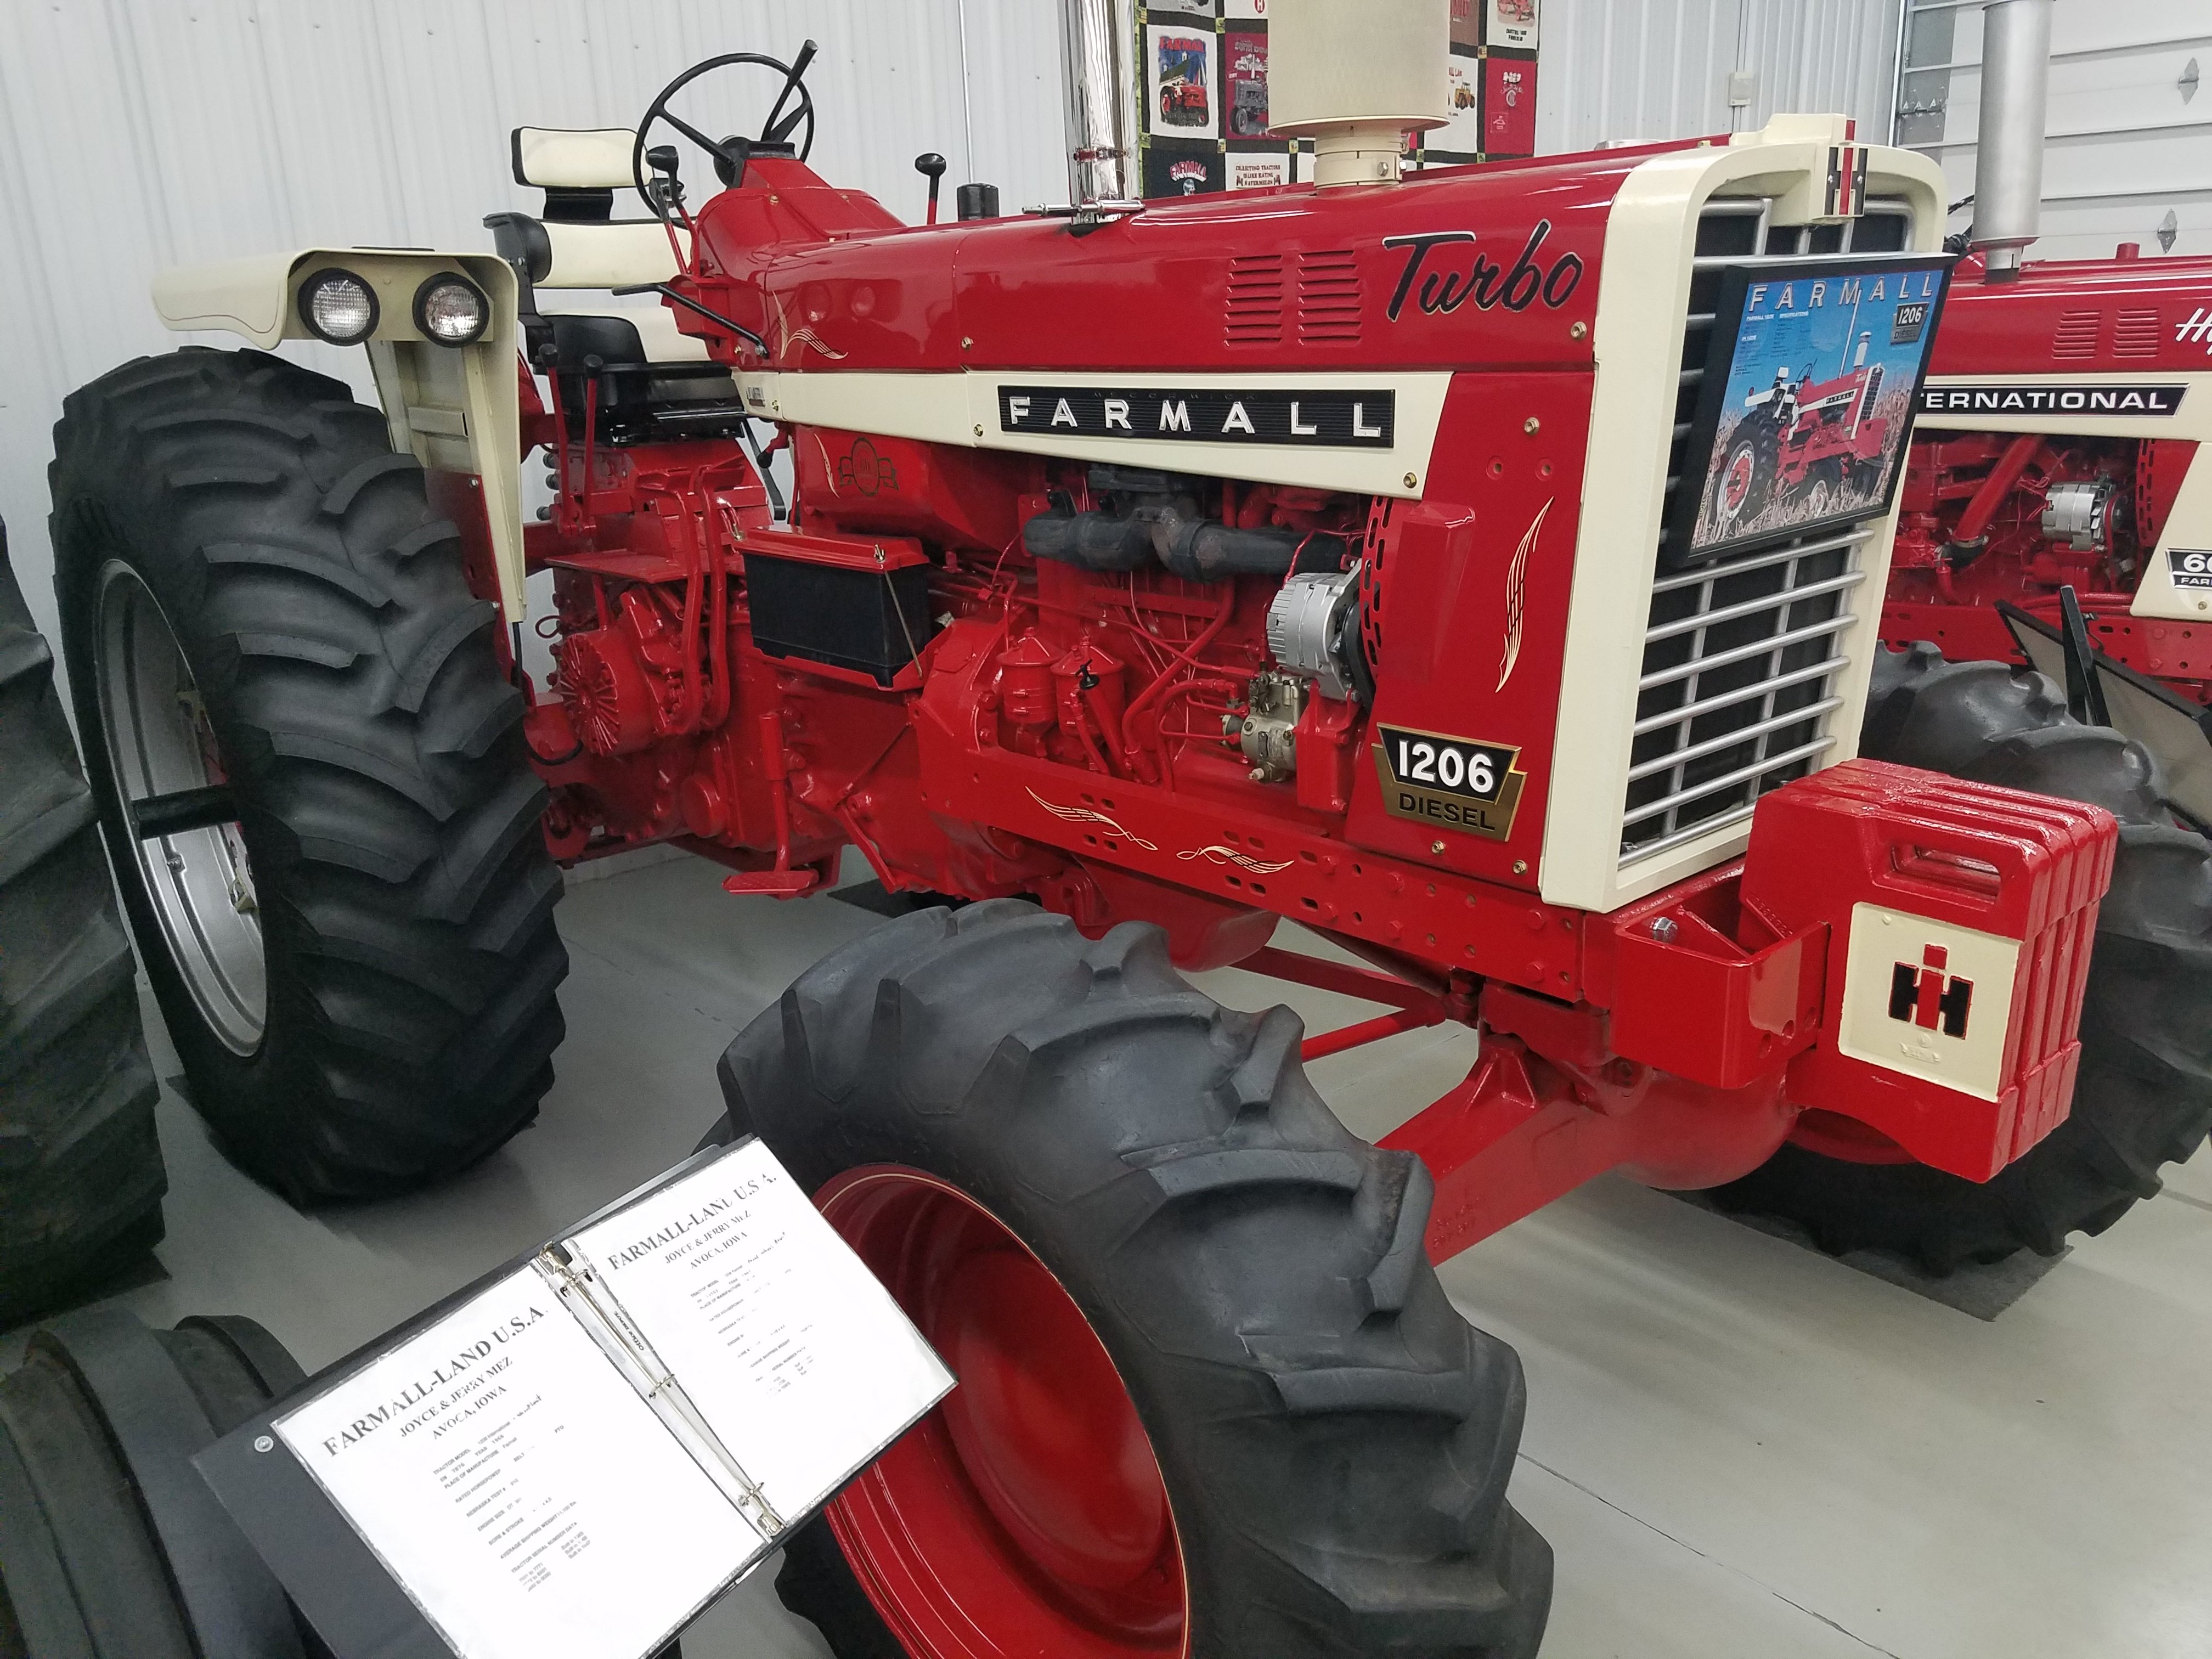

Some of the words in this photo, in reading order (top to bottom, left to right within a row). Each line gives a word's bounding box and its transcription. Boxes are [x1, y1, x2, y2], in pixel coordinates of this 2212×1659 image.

[1170, 160, 1206, 182] FARMALL
[1382, 218, 1584, 323] Turbo
[1748, 277, 1932, 312] FARMALL
[1898, 306, 1923, 325] 1206
[2175, 307, 2212, 356] H
[1009, 396, 1381, 437] FARMALL
[2181, 577, 2212, 585] FAR
[2183, 553, 2212, 572] 6
[1398, 740, 1494, 793] 1206
[1398, 793, 1496, 831] DIESEL
[665, 1244, 691, 1263] JOYCE
[704, 1223, 730, 1241] JERRY
[323, 1341, 490, 1456] FARMALL-LAND
[400, 1407, 439, 1436] JOYCE
[441, 1401, 450, 1409] &
[451, 1375, 484, 1402] JERRY
[486, 1357, 512, 1378] MEZ
[433, 1410, 476, 1439] AVOCA,
[475, 1386, 506, 1409] IOWA
[433, 1459, 455, 1475] TRACTOR
[455, 1449, 470, 1460] MODEL
[444, 1477, 460, 1488] PLACE
[466, 1450, 499, 1473] MANUFACTURE
[475, 1447, 487, 1456] YEAR
[455, 1491, 471, 1503] RATED
[514, 1453, 524, 1462] BELT
[466, 1498, 491, 1517] NEBRASKA
[490, 1489, 502, 1499] TEST
[478, 1517, 495, 1531] ENGINE
[494, 1510, 505, 1519] SIZE
[488, 1534, 502, 1545] BORE
[505, 1517, 524, 1532] STROKE
[501, 1542, 521, 1559] AVERAGE
[521, 1527, 541, 1543] SHIPPING
[541, 1514, 557, 1527] WEIGHT
[511, 1556, 532, 1573] TRACTOR
[532, 1545, 548, 1557] SERIAL
[548, 1531, 566, 1545] NUMBER
[565, 1522, 577, 1532] DATA
